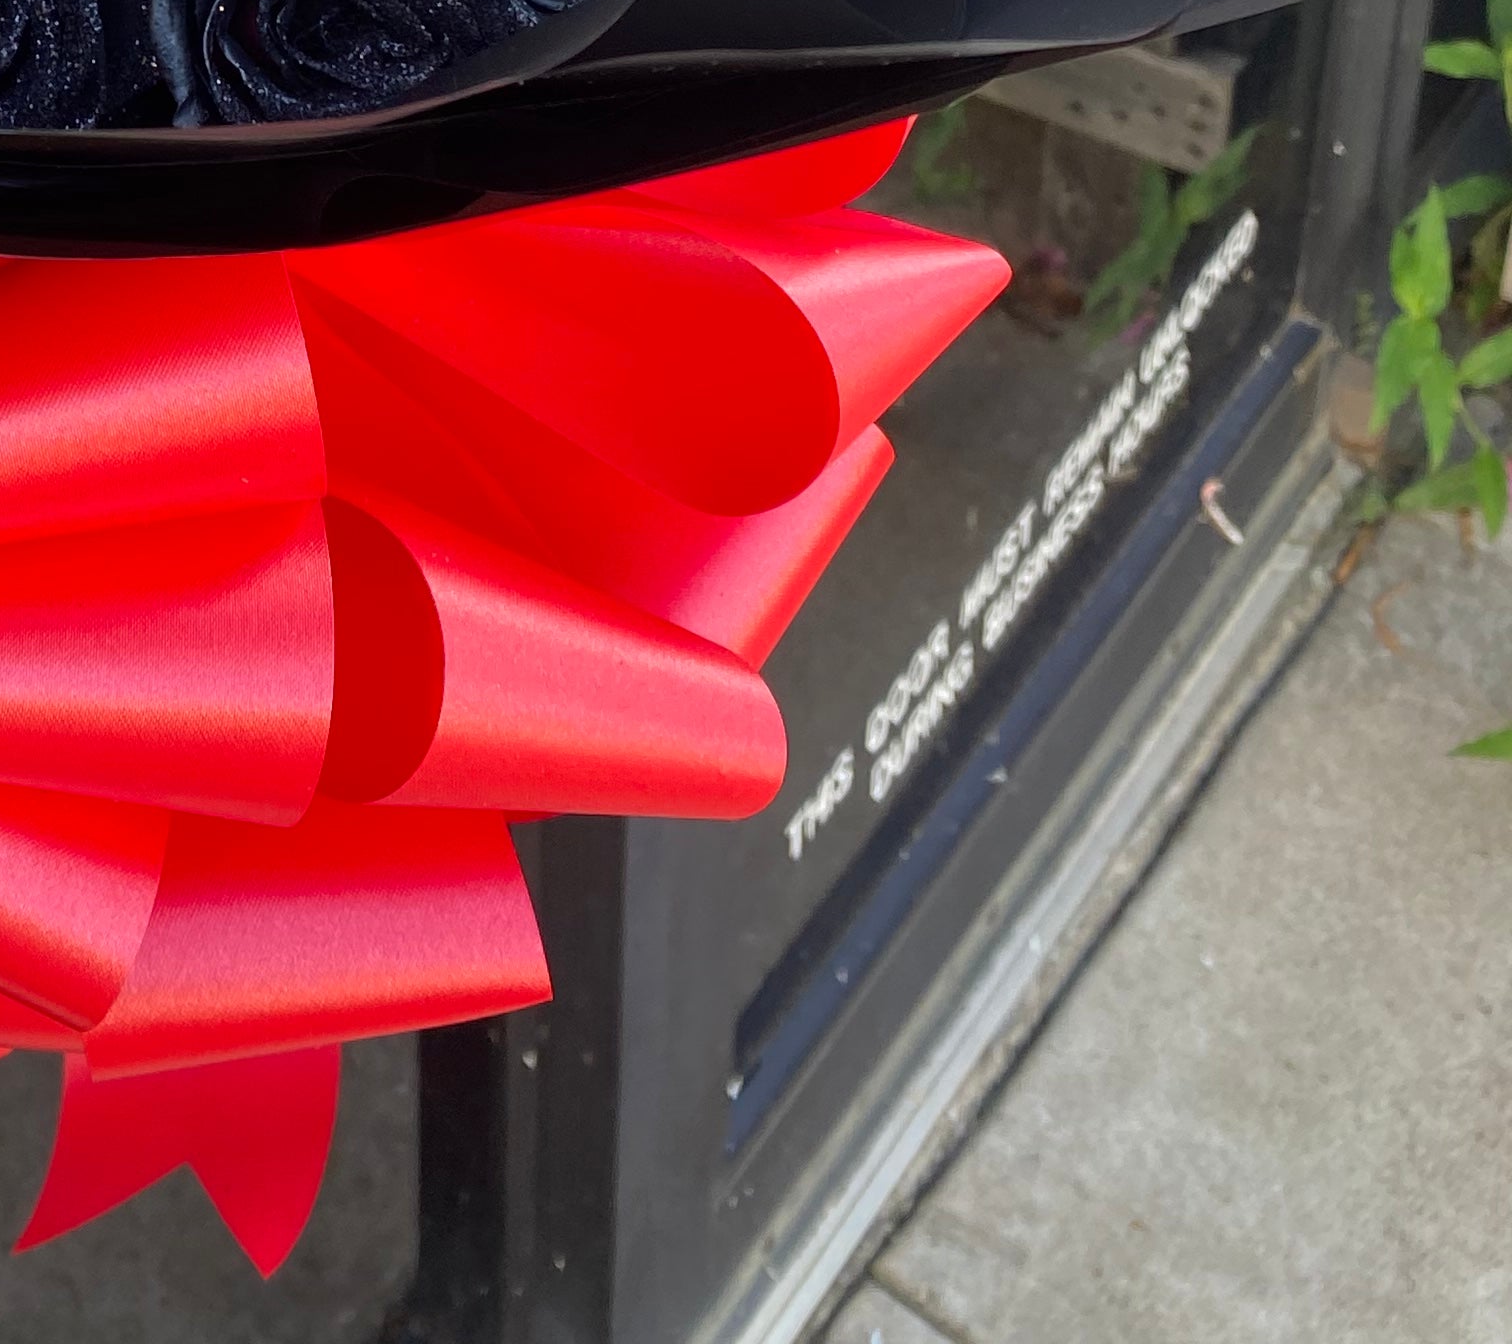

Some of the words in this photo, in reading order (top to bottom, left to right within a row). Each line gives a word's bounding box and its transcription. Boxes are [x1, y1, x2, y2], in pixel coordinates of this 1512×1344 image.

[784, 746, 854, 860] THIS
[864, 618, 950, 753] DOOR
[958, 498, 1037, 630] MUST
[1043, 367, 1137, 516] REMAIN
[869, 639, 975, 803] DURING
[982, 464, 1106, 653] BUSINESS
[1109, 344, 1191, 476] HOURS
